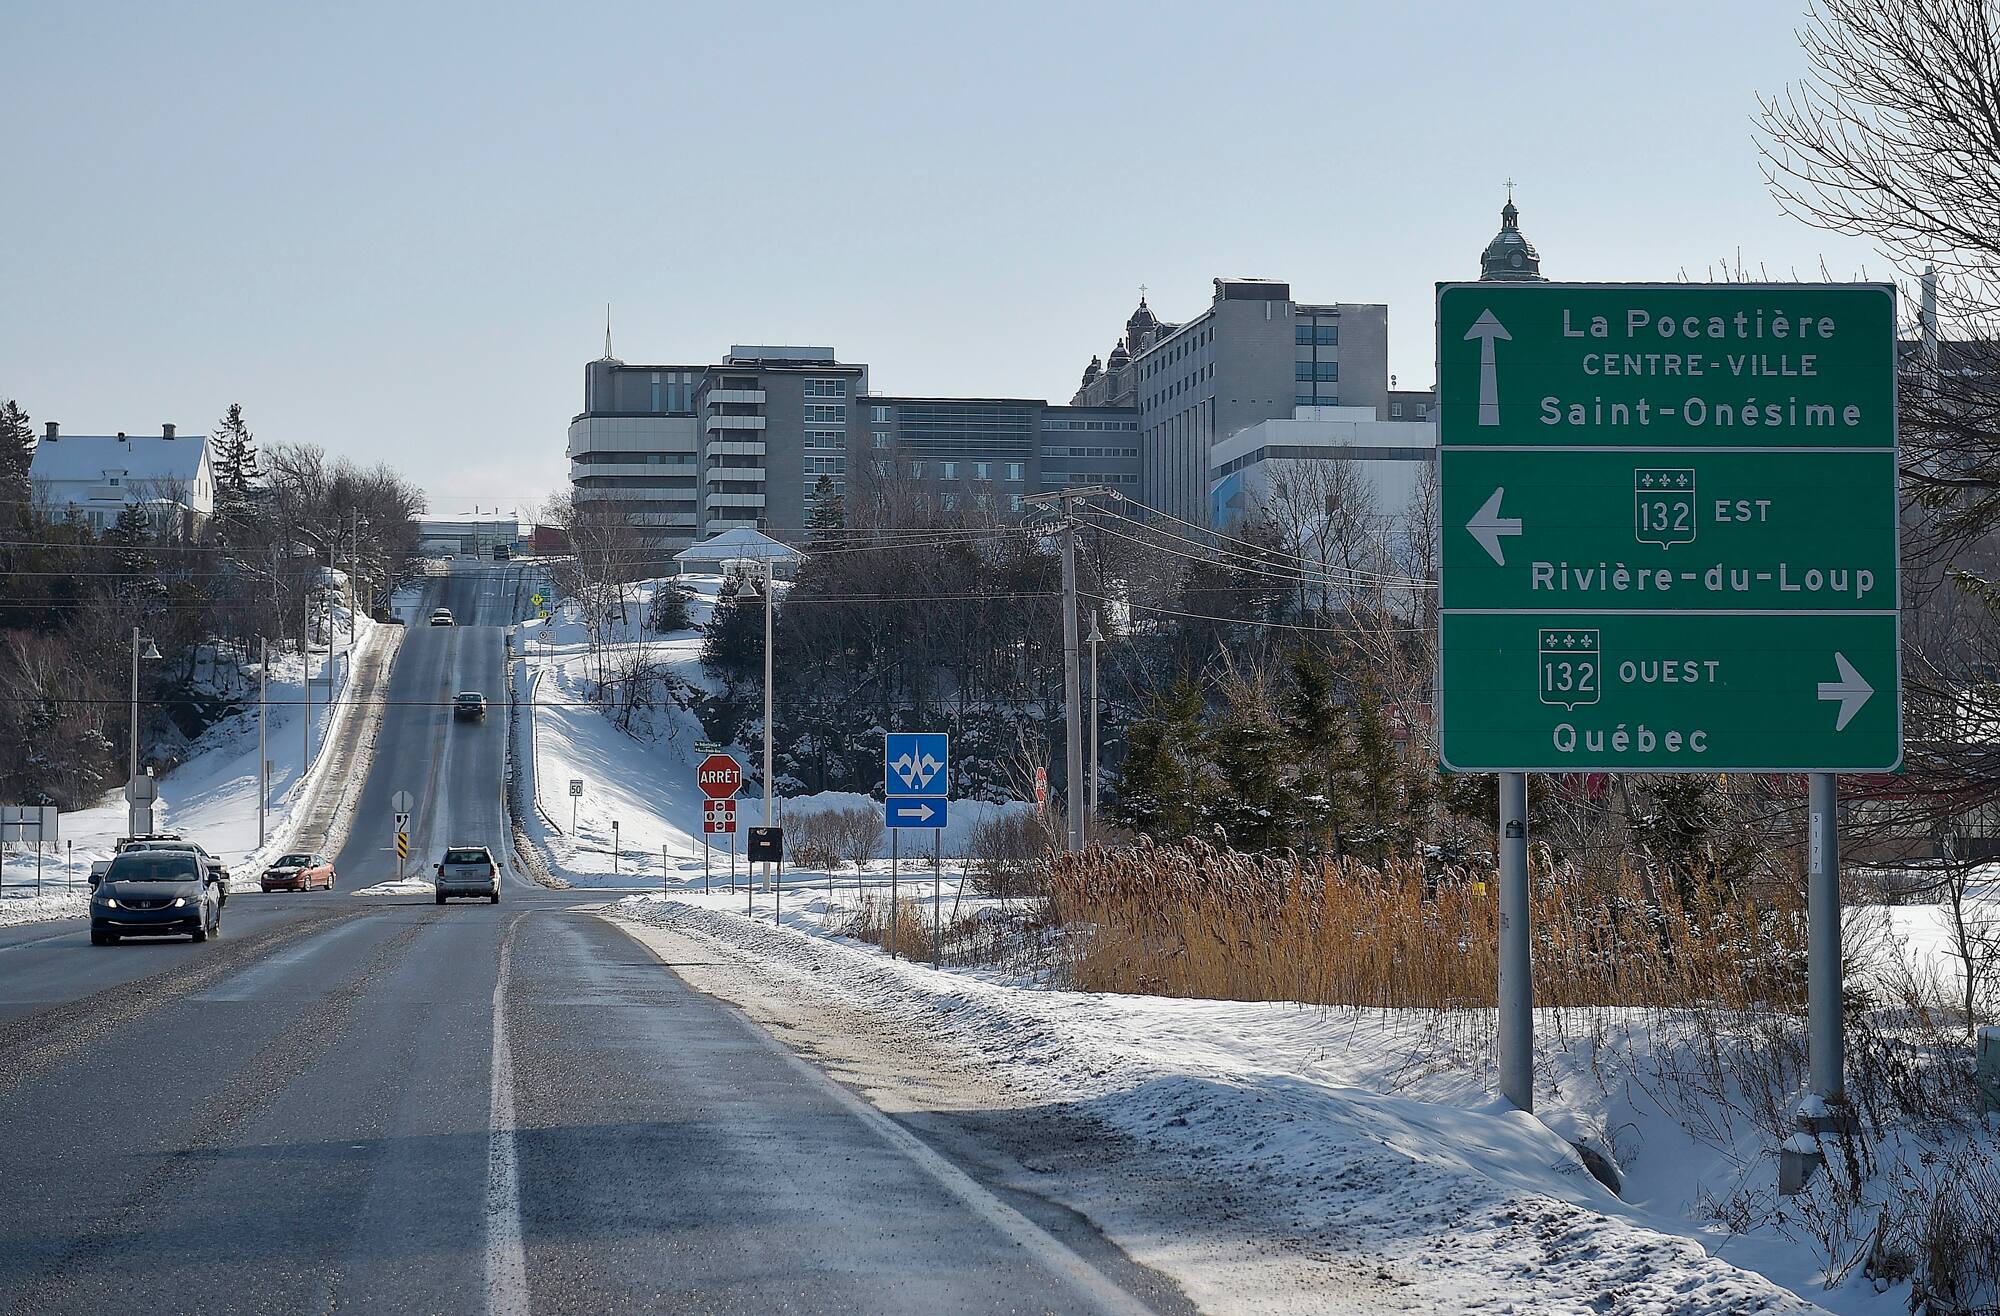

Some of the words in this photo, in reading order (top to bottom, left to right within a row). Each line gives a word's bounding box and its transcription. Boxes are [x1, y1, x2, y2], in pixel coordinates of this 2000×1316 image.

[1563, 309, 1608, 338] La
[1627, 309, 1835, 339] Pocatière
[1583, 353, 1817, 376] CENTRE-VILLE
[1539, 396, 1861, 427] Saint-Onésime
[1641, 502, 1690, 531] 132
[1715, 500, 1771, 522] EST
[1532, 561, 1874, 599] Rivière-du-Loup
[1545, 662, 1594, 691] 132
[1619, 660, 1720, 683] OUEST
[1553, 723, 1708, 753] Québec
[571, 785, 582, 794] 50
[700, 768, 739, 784] ARRÊT
